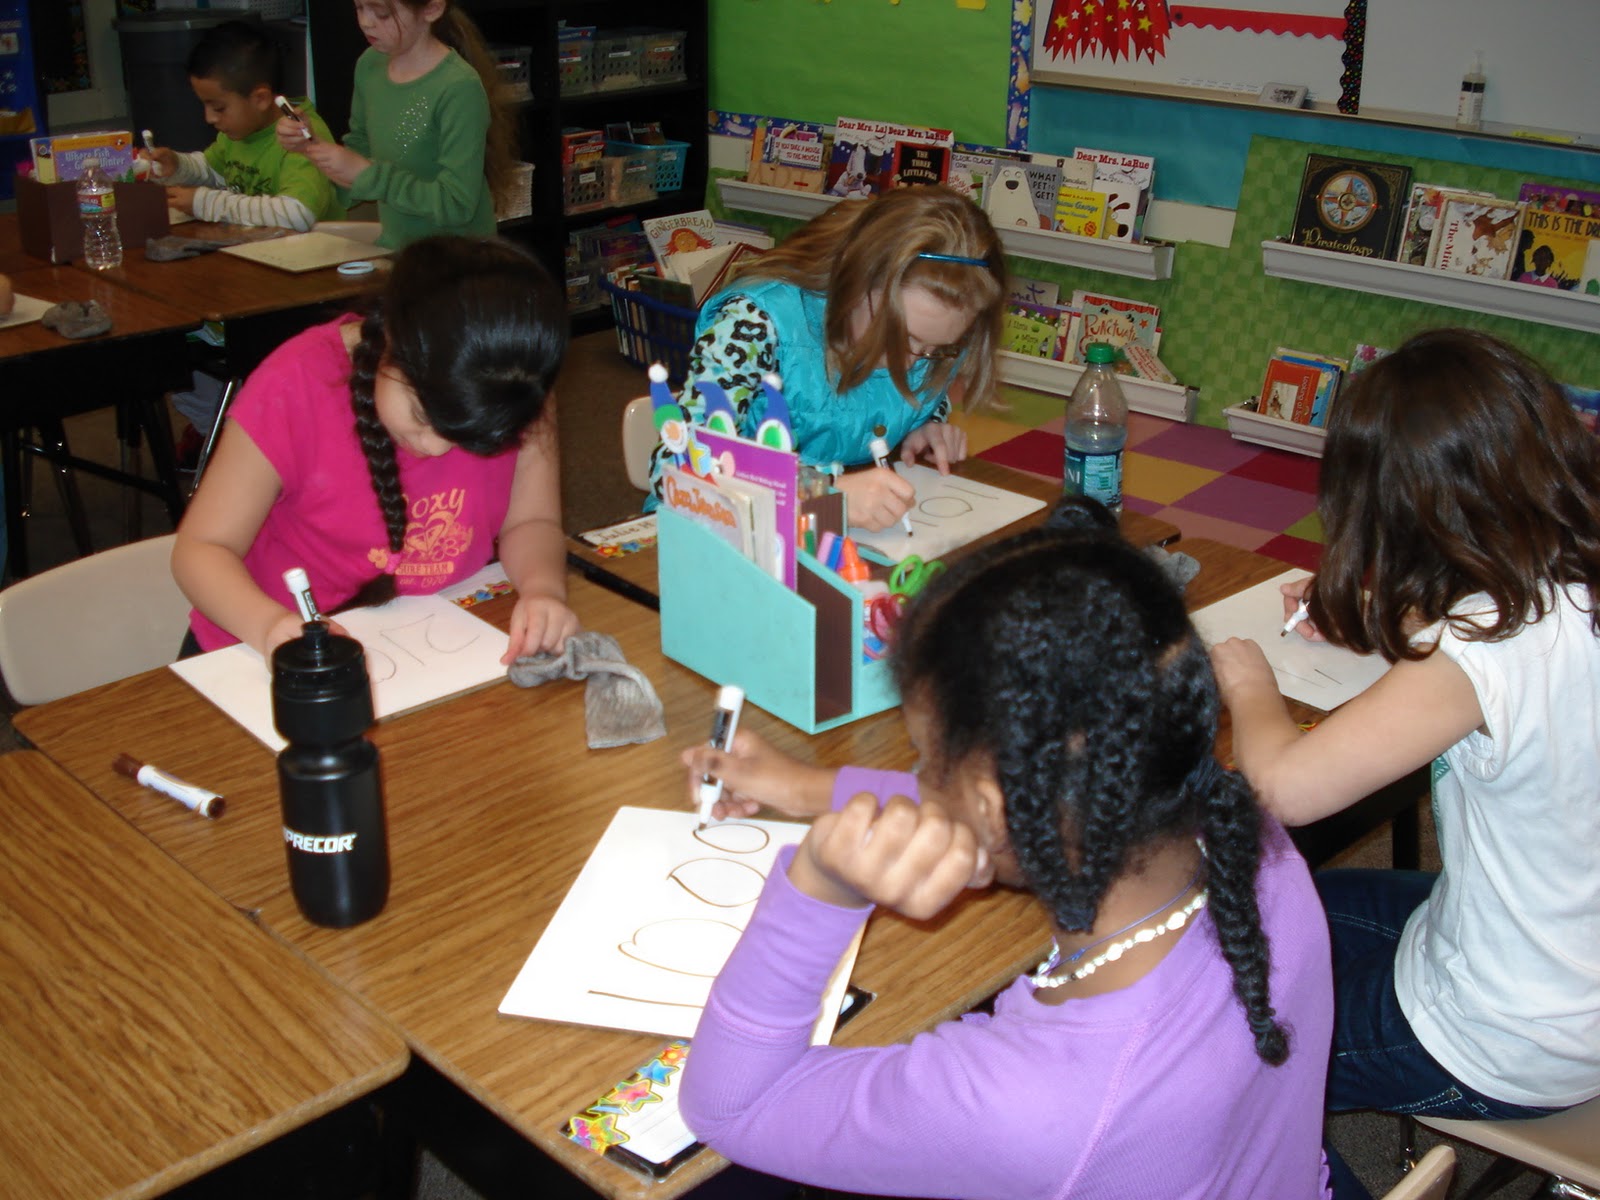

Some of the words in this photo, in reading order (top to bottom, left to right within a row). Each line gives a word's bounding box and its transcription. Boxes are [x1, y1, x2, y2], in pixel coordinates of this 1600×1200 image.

[838, 120, 856, 129] Dear
[856, 122, 874, 132] Mrs.
[889, 126, 906, 136] Dear
[906, 129, 924, 139] Mrs.
[65, 151, 92, 161] Where
[94, 147, 110, 159] Fish
[916, 150, 928, 159] THE
[1076, 151, 1097, 162] Dear
[1098, 154, 1119, 165] Mrs.
[1121, 157, 1150, 169] LaRue
[911, 159, 932, 169] THREE
[903, 168, 924, 177] LITTLE
[924, 171, 938, 181] PIGS
[1029, 171, 1057, 182] WHAT
[1033, 181, 1046, 190] PET
[1035, 191, 1055, 200] GET?
[650, 216, 713, 239] GINGERBREAD
[1529, 211, 1550, 229] THIS
[1552, 215, 1561, 231] IS
[1564, 217, 1585, 235] THE
[1447, 220, 1459, 243] The
[1301, 226, 1374, 257] Pirateology
[1440, 243, 1455, 270] Mitt
[402, 488, 466, 520] oxy
[284, 825, 354, 853] PRECOR
